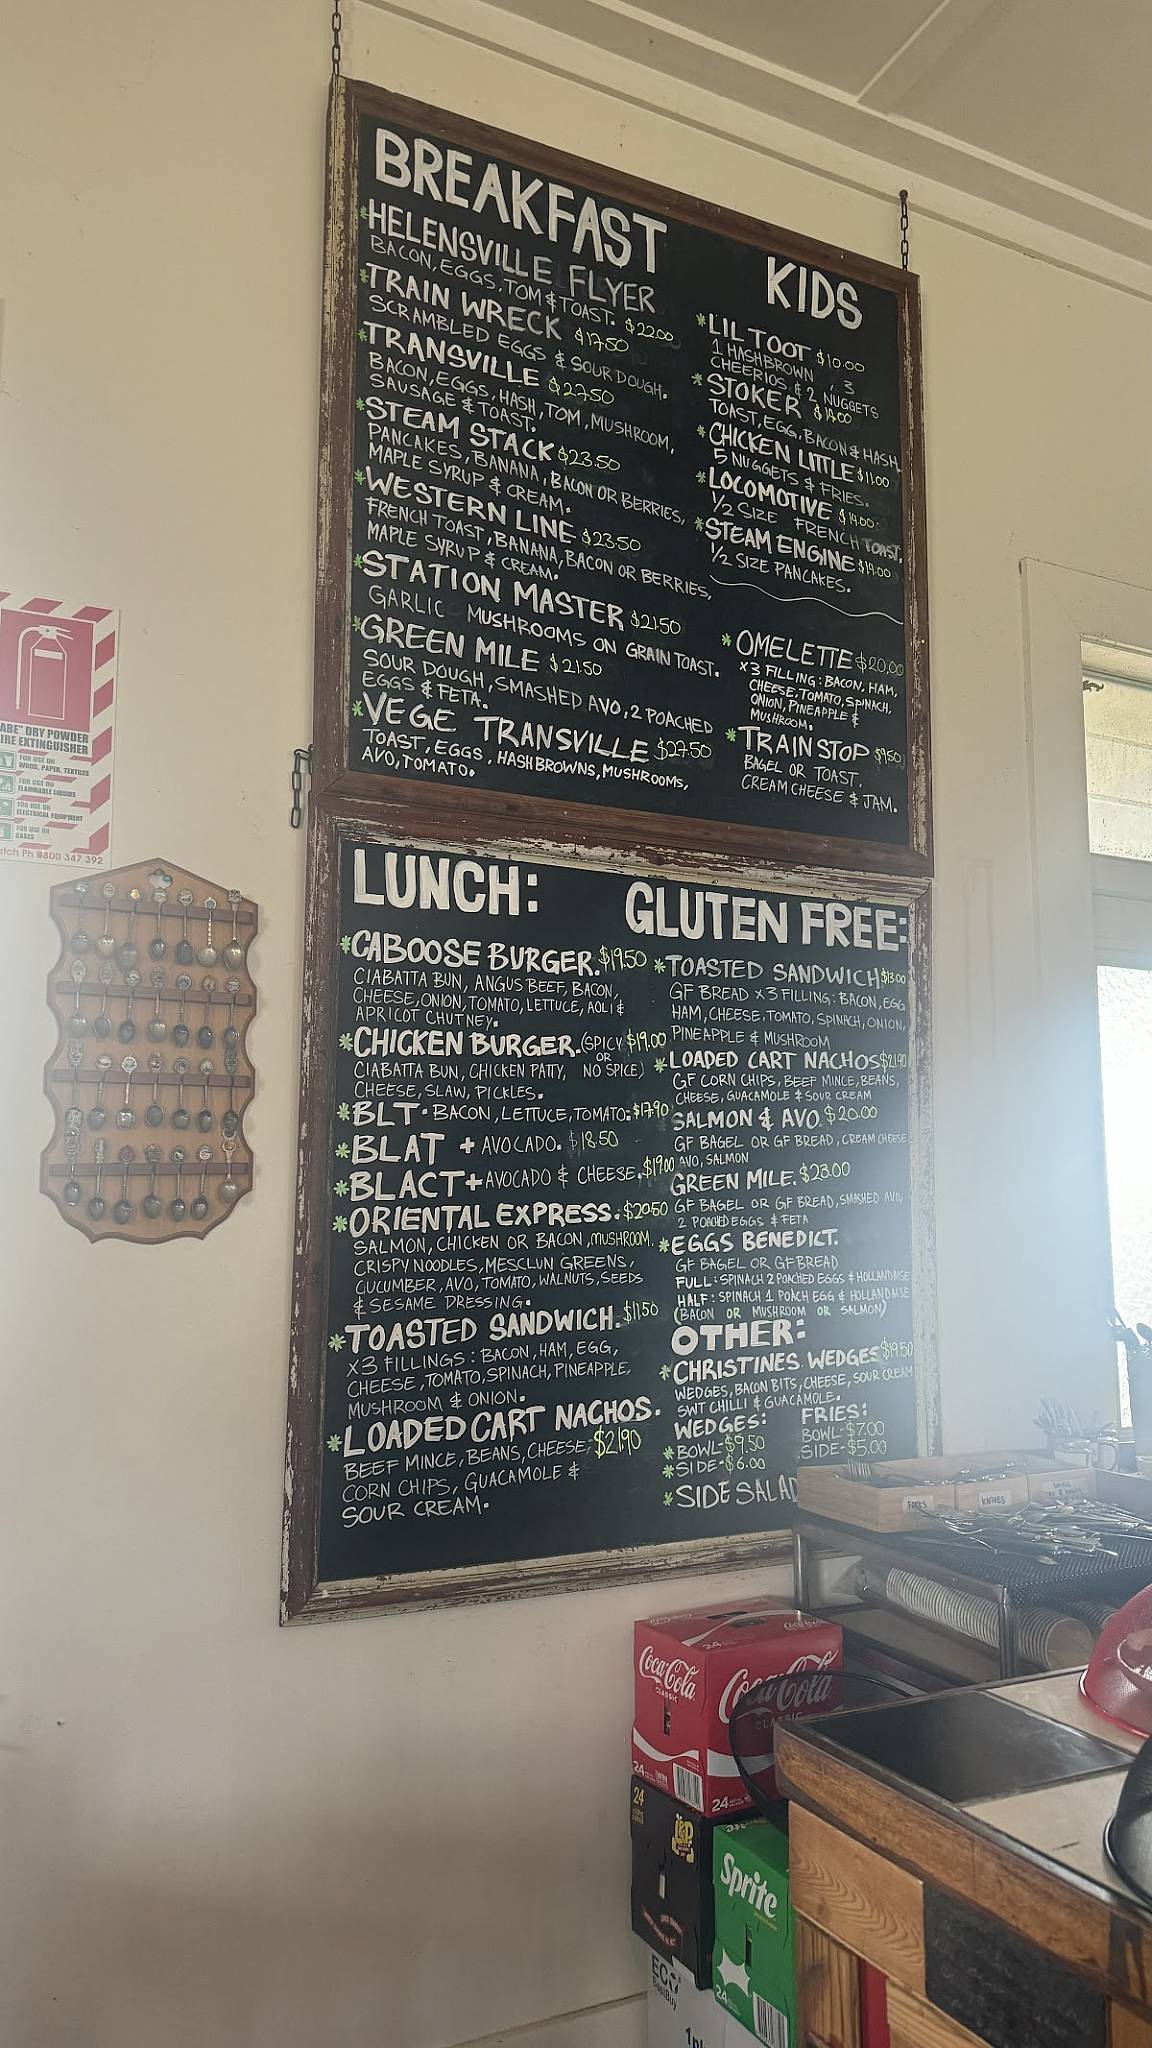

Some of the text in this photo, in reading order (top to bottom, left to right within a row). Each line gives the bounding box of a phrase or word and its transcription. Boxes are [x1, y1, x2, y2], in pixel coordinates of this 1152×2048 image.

[375, 128, 668, 274] BREAKFAST
[368, 198, 656, 313] HELENSVILLE FLYER
[365, 262, 562, 340] TRAIN WRECK
[768, 256, 863, 330] KIDS
[369, 294, 546, 361] SCRAMBLED EGGS
[708, 313, 865, 373] LIL TOOT $10.00
[363, 320, 540, 387] TRANSVILLE
[370, 373, 456, 407] SAUSAGE
[463, 399, 474, 414] &
[707, 373, 801, 418] STOKER
[365, 396, 621, 471] STEAM STACK $23.50
[709, 422, 855, 483] CHICKEN LITTLE
[369, 444, 571, 515] MAPLE SYRUP & CREAM.
[709, 466, 833, 520] LOCOMOTIVE
[714, 448, 869, 508] 5 NUGGETS & FRIES.
[365, 466, 641, 551] WESTERN LINE $23.50
[738, 502, 778, 523] SIZE
[794, 517, 858, 549] FRENCH
[705, 517, 856, 572] STEAM ENGINE
[362, 550, 624, 631] STATION MASTER
[736, 553, 851, 592] SIZE PANCAKES.
[360, 614, 540, 672] GREEN MILE
[369, 585, 720, 678] GARLIC MUSHROOMS ON GRAIN TOAST.
[736, 630, 853, 670] OMELETTE
[363, 672, 488, 710] EGGS & FETA.
[19, 737, 88, 754] EXTINGUISHER
[26, 727, 45, 737] DRY
[48, 729, 89, 743] POWDER
[363, 691, 650, 763] VEGE TRANSVILLE
[738, 726, 870, 762] TRAIN STOP
[744, 754, 806, 778] BAGEL OR
[742, 774, 898, 813] CREAM CHEESE & JAM.
[65, 855, 82, 863] 347
[85, 856, 103, 864] 392
[353, 849, 538, 916] LUNCH:
[625, 881, 907, 951] GLUTEN FREE:
[351, 930, 481, 966] CABOOSE
[487, 942, 600, 977] BURGER.
[665, 954, 881, 988] TOASTED SANDWICH
[356, 1007, 499, 1030] APRICOT CHUTNEY.
[671, 1025, 830, 1050] PINEAPPLE & MUSHROOM
[353, 1026, 582, 1058] CHICKEN BURGER.
[669, 1051, 881, 1070] LOADED CART NACHOS
[354, 1061, 424, 1080] CIABATTA
[430, 1063, 465, 1080] BUN,
[469, 1063, 525, 1079] CHICKEN
[673, 1108, 753, 1131] SALMON
[758, 1106, 774, 1131] &
[824, 1104, 877, 1124] $20.00
[352, 1133, 562, 1165] BLAT AVOCADO.
[671, 1168, 796, 1196] GREEN MILE.
[350, 1205, 490, 1238] ORIENTAL
[671, 1228, 839, 1256] EGGS BENEDICT.
[353, 1295, 531, 1319] & SESAME DRESSING.
[345, 1306, 621, 1354] TOASTED SANDWICH.
[671, 1318, 806, 1356] OTHER:
[673, 1346, 880, 1385] CHRISTINES WEDGES
[348, 1389, 526, 1420] MUSHROOM & ONION.
[801, 1403, 867, 1424] FRIES:
[343, 1396, 661, 1458] LOADED CART NACHOS.
[674, 1414, 766, 1440] WEDGES:
[342, 1461, 579, 1502] CORN CHIPS, GUACAMOLE &
[676, 1481, 730, 1509] SIDE
[341, 1496, 489, 1528] SOUR CREAM.
[633, 1760, 645, 1777] 24
[634, 1786, 645, 1806] 24
[712, 1796, 729, 1813] 24
[720, 1852, 778, 1919] Sprite
